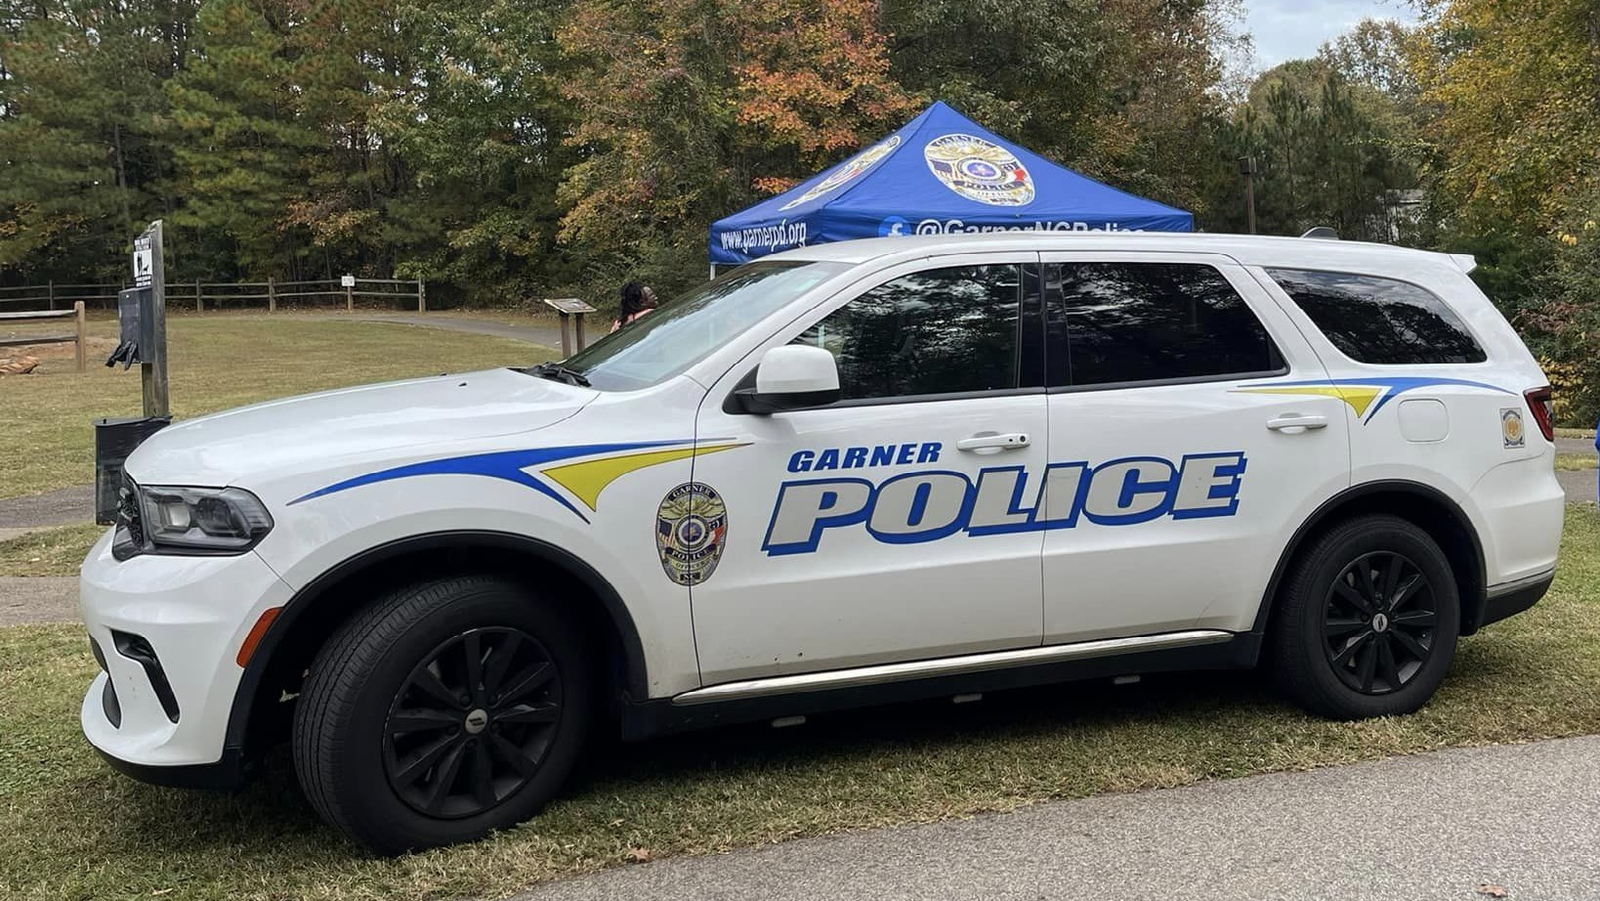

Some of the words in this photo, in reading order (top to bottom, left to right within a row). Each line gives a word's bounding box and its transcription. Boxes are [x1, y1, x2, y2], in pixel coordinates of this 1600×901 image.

[720, 218, 807, 254] www.garnerpd.org
[916, 218, 1145, 236] @GarNCPli
[787, 441, 943, 473] GARNER
[672, 484, 712, 498] GARNER
[761, 451, 1248, 557] POLICE
[671, 548, 709, 561] POLICE
